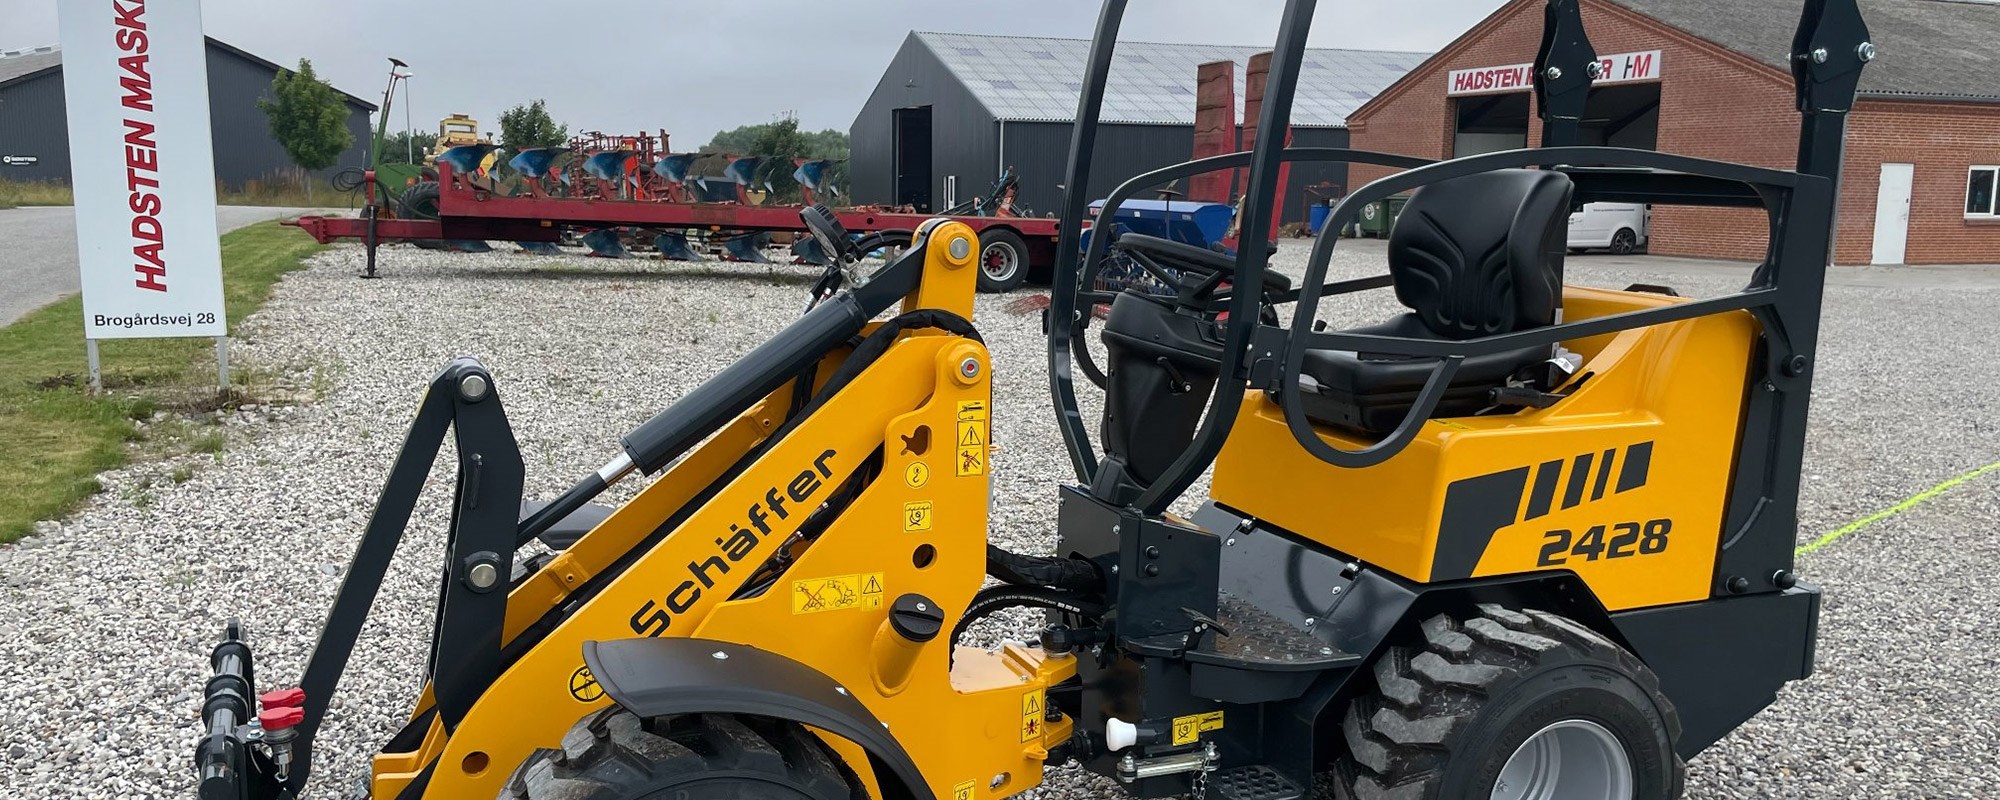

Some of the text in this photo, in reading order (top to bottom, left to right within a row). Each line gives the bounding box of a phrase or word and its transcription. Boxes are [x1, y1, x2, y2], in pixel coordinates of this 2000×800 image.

[1454, 67, 1523, 91] HADSTEN
[122, 119, 167, 293] HADSTEN
[94, 312, 216, 328] Brogårdsvej 28
[630, 449, 837, 638] Schäffer
[1536, 518, 1672, 567] 2428
